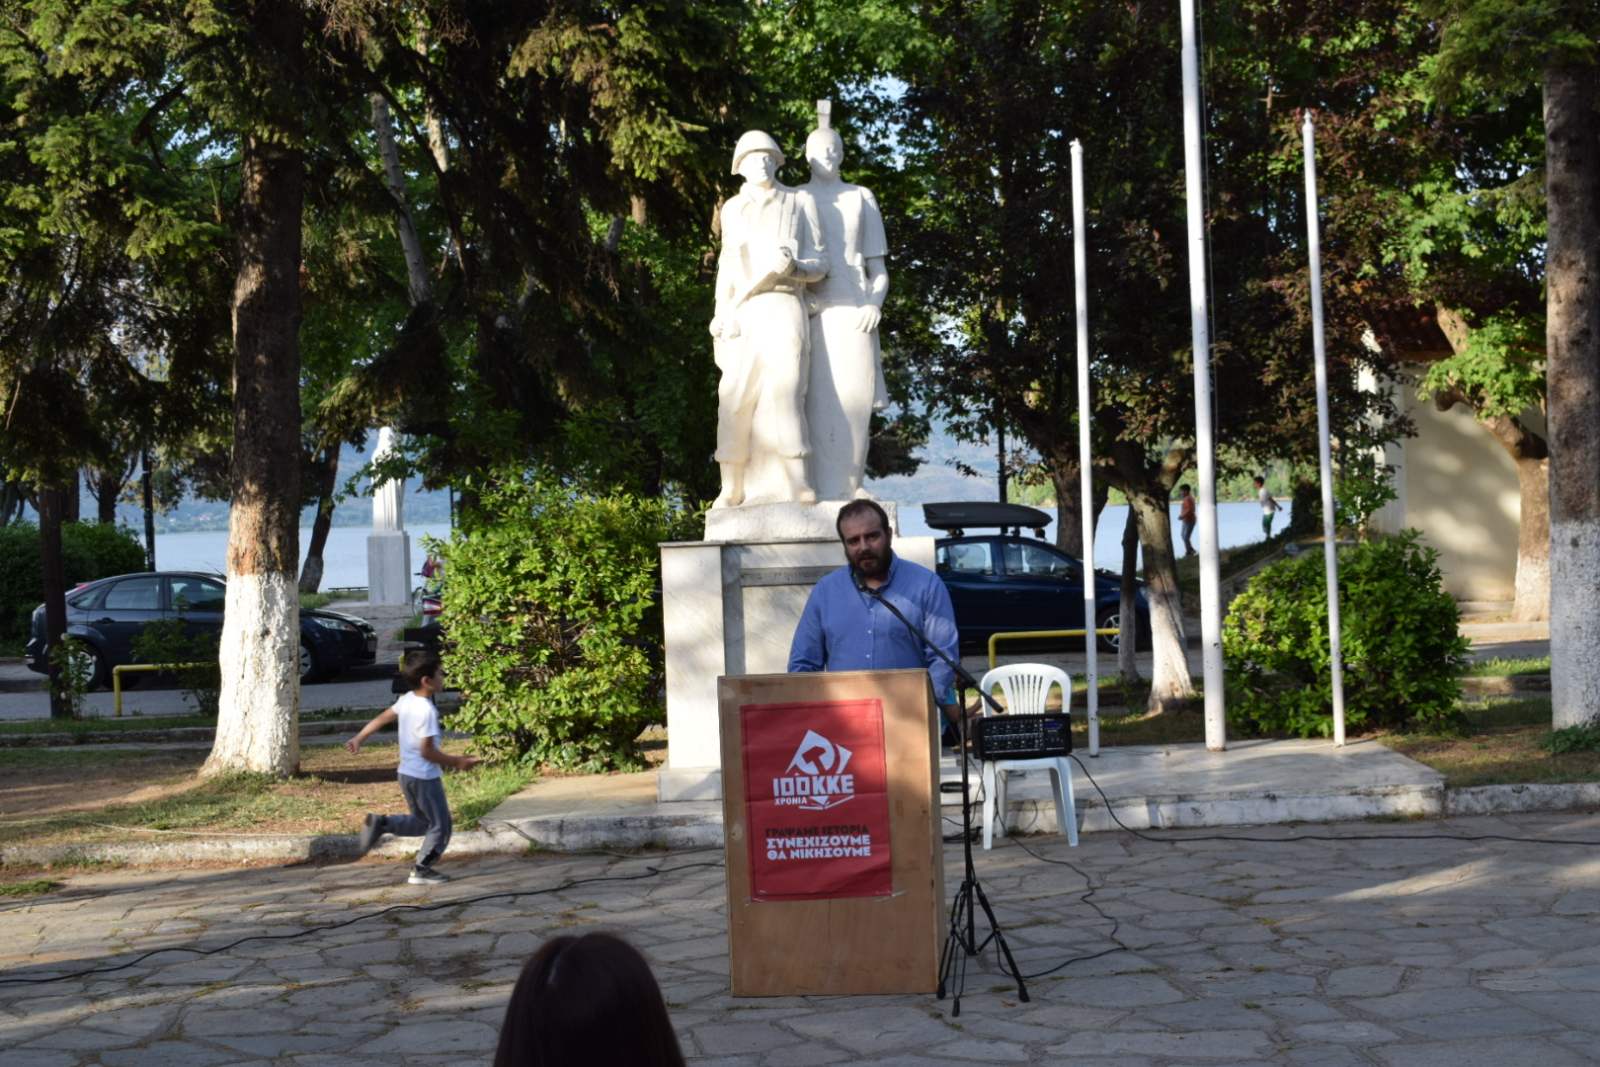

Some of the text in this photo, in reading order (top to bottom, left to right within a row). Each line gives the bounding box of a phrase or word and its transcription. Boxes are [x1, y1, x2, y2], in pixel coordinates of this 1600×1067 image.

[775, 796, 808, 805] ΧΡΟΝΙΑ
[767, 834, 870, 848] ΣΥΝΕΧΙΖΟΥΜΕ
[767, 846, 871, 861] ΘΑ ΝΙΚΗΣΟΥΜΕ
